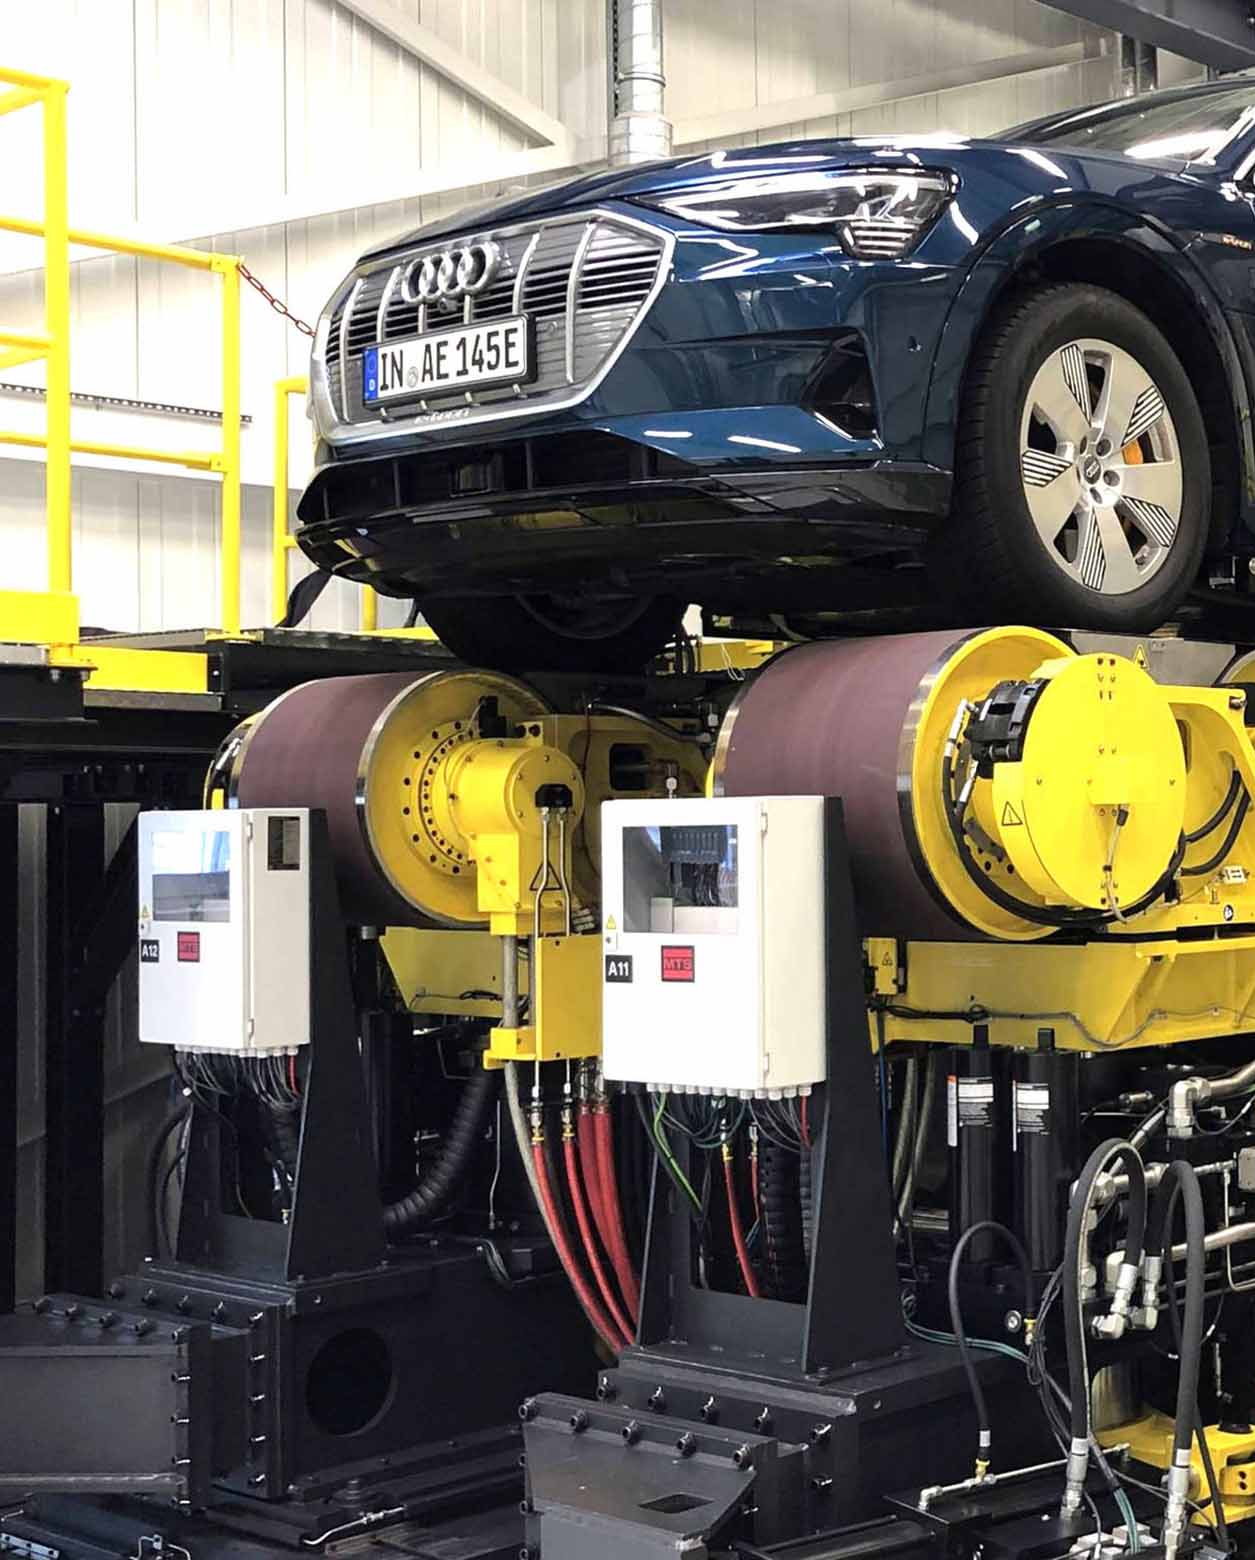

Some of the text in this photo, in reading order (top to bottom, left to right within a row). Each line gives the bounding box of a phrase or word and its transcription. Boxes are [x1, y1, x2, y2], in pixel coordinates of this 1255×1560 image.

[380, 327, 519, 392] IN AE 145E
[142, 944, 158, 957] A12
[608, 961, 629, 976] A11
